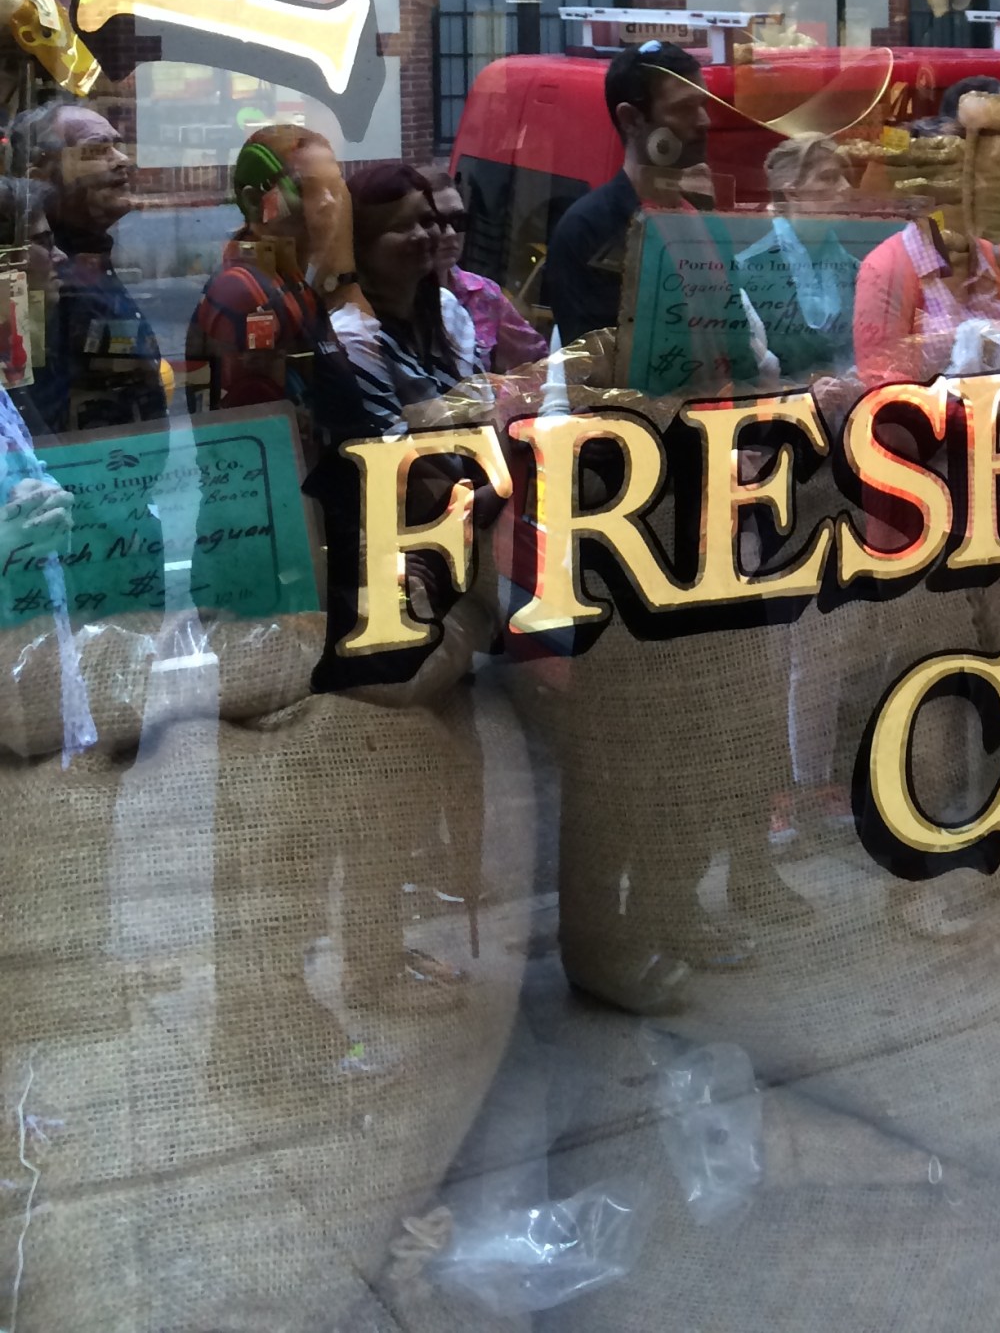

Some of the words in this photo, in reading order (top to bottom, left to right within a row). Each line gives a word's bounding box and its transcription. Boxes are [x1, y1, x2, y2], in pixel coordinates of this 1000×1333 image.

[679, 259, 724, 272] Porto
[663, 273, 734, 297] Organic
[215, 459, 244, 471] Co.
